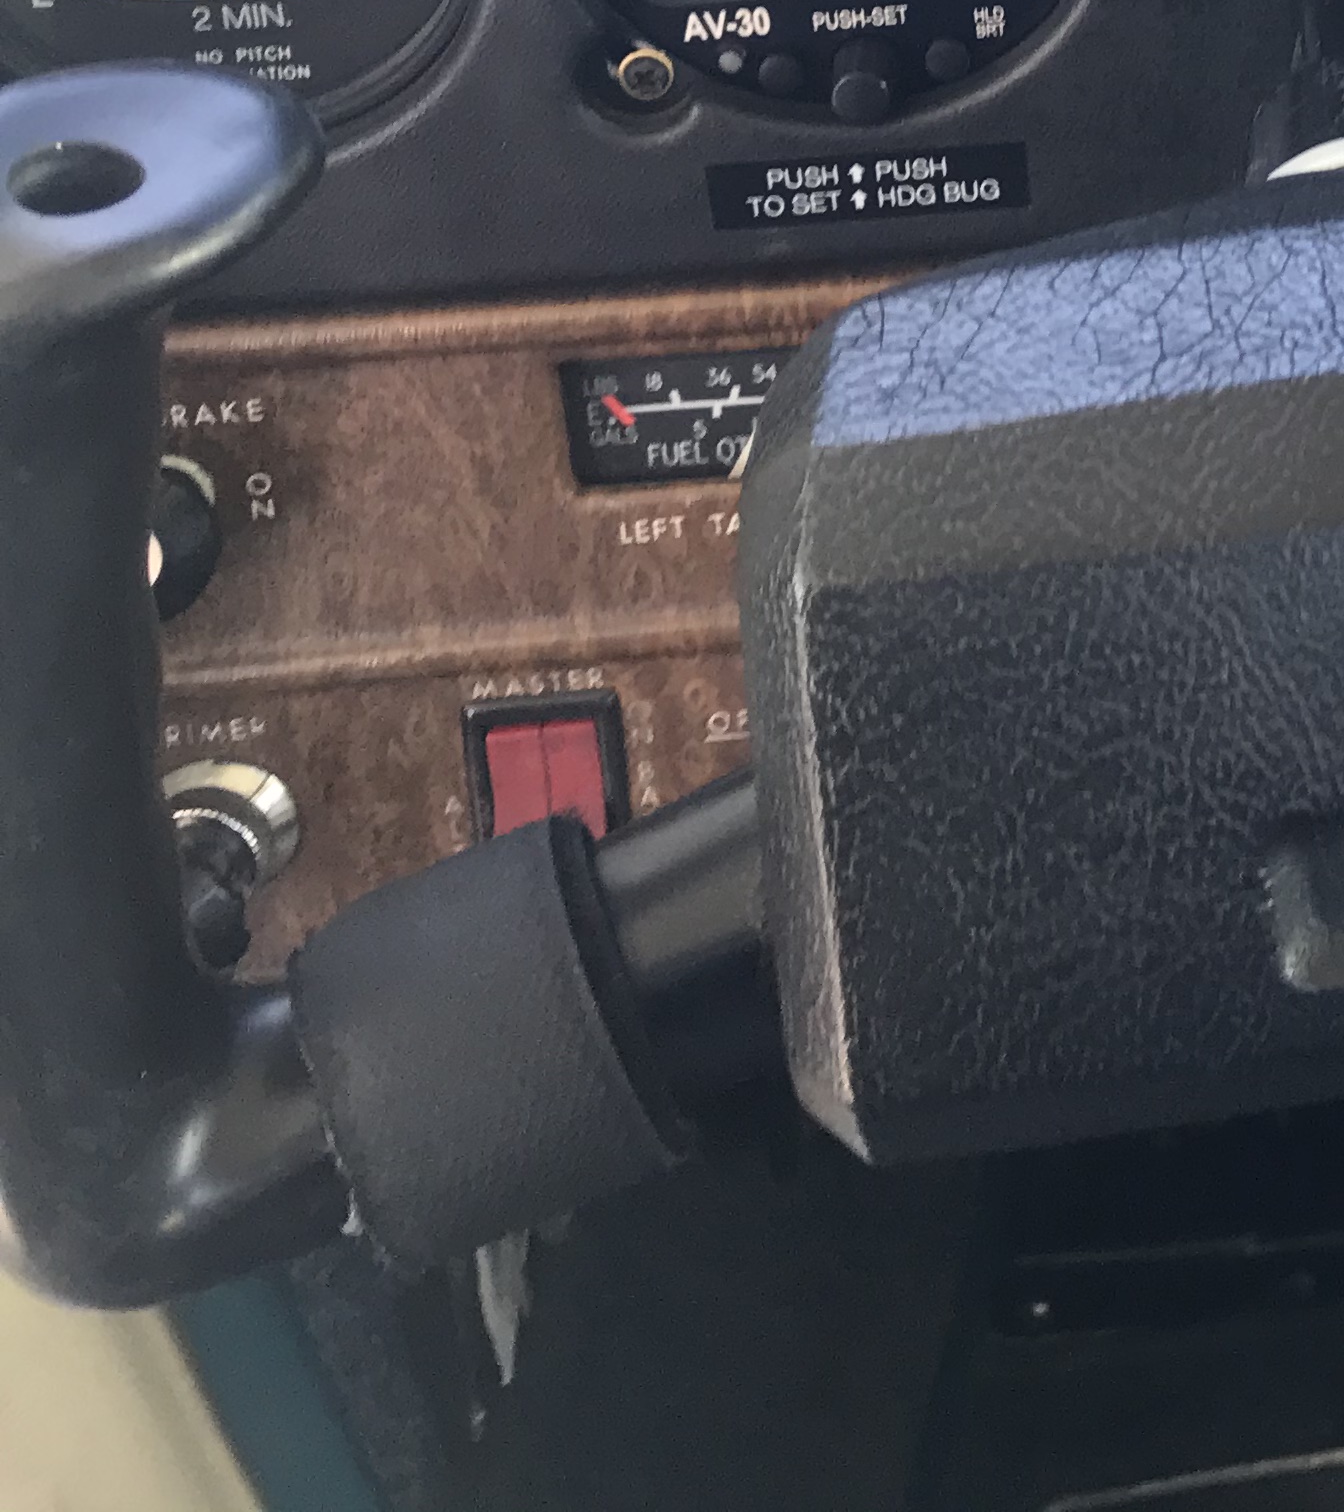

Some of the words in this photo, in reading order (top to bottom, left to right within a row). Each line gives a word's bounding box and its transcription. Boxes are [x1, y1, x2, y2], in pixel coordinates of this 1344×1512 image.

[191, 8, 213, 32] 2
[222, 2, 293, 30] MIN.
[683, 6, 771, 43] AV-30
[812, 5, 908, 32] PUSH-SET
[973, 6, 1004, 24] HLD
[195, 47, 223, 64] NO
[235, 44, 291, 63] PITCH
[767, 164, 839, 190] PUSH
[875, 156, 948, 182] PUSH
[746, 195, 784, 219] TO
[791, 190, 839, 215] SET
[878, 183, 936, 208] HDG
[943, 178, 1000, 204] BUG
[647, 440, 710, 469] FUEL
[246, 472, 276, 521] ON
[619, 514, 685, 546] LEFT
